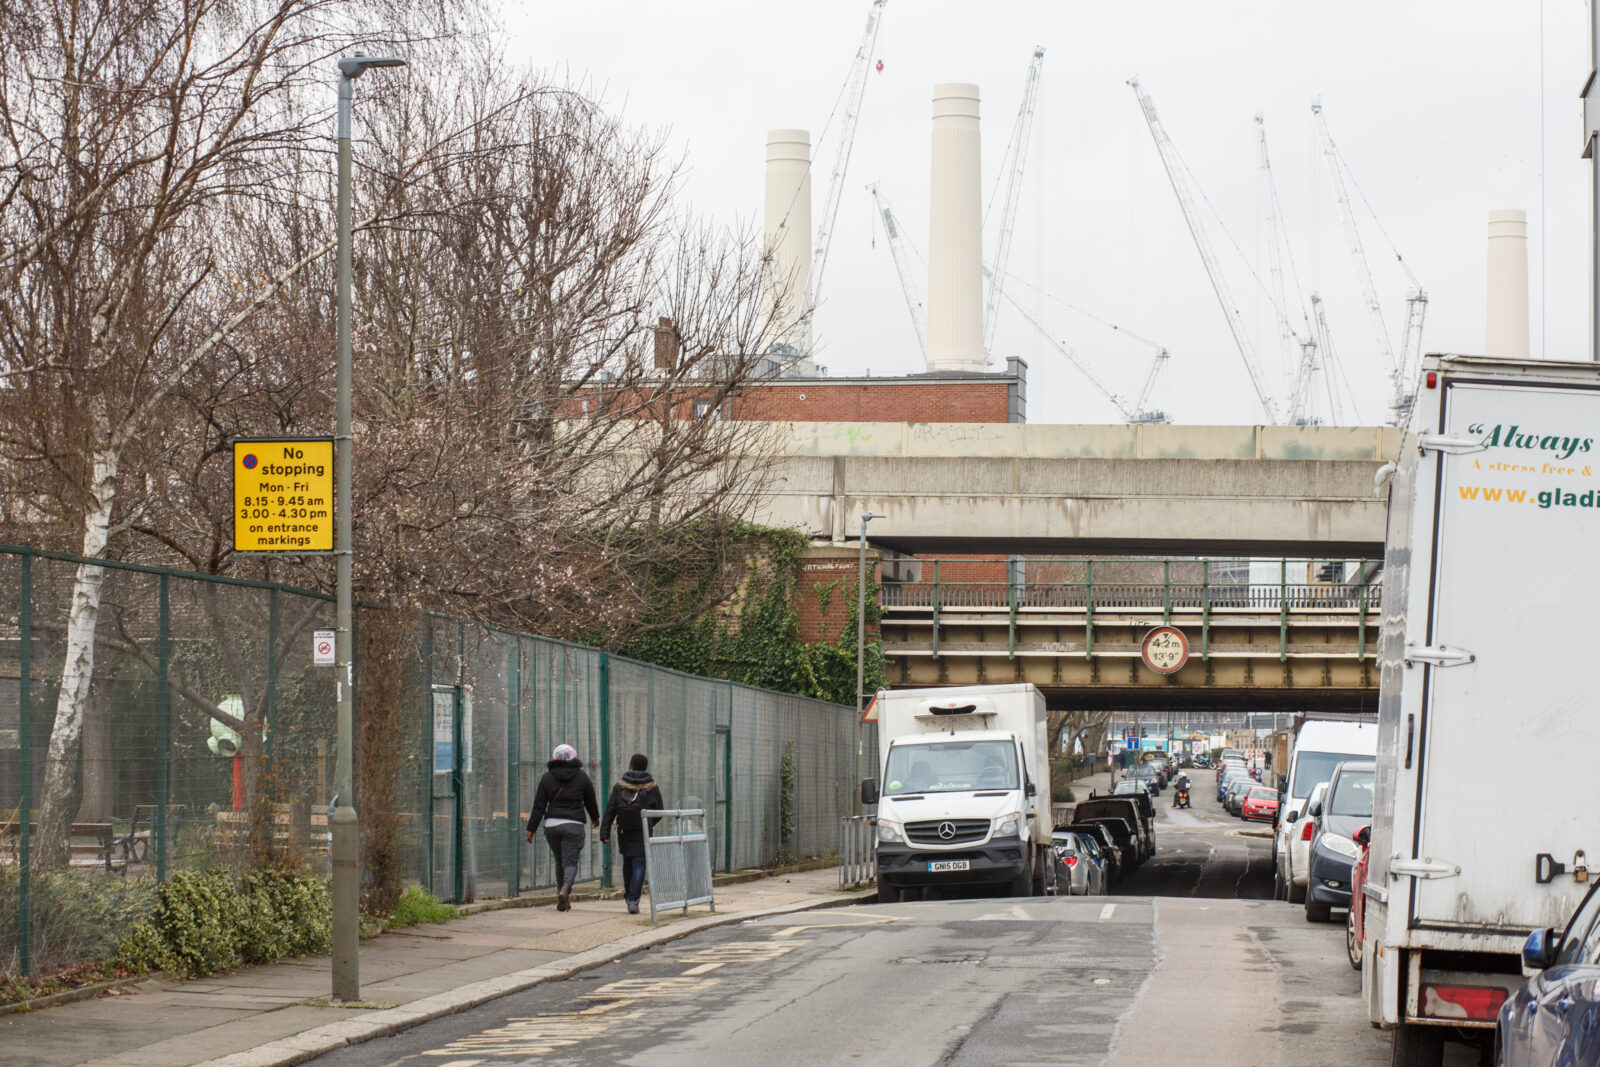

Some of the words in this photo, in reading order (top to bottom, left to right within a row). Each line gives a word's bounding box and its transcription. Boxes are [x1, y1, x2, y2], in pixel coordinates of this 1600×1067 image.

[283, 447, 304, 459] No
[261, 463, 325, 477] stopping
[1472, 459, 1482, 470] A
[1488, 461, 1536, 473] stress
[1541, 463, 1575, 476] free
[1581, 465, 1592, 477] &
[259, 482, 284, 492] Mon
[294, 482, 309, 492] Fri
[249, 524, 263, 533] on
[267, 523, 319, 533] entrance
[257, 535, 311, 546] markings
